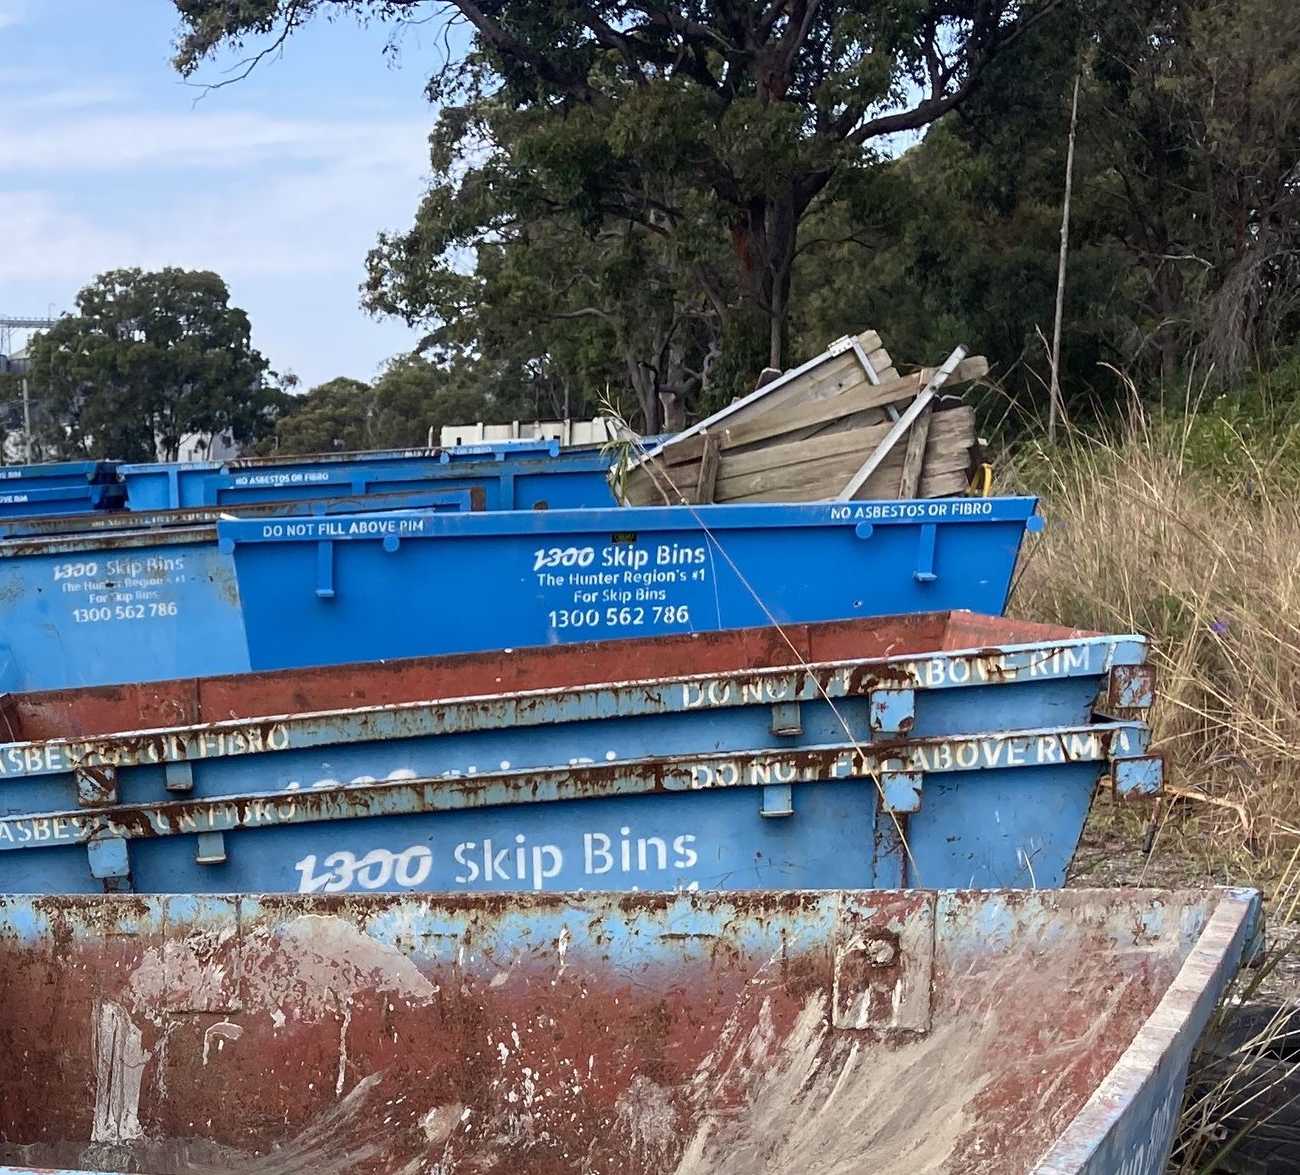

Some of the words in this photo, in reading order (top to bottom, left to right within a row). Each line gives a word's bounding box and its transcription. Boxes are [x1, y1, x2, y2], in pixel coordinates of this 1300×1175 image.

[831, 507, 850, 519] NO
[854, 505, 924, 518] ASBESTOS
[928, 504, 946, 515] OR
[952, 503, 992, 515] FIBRO
[263, 525, 282, 537] DO
[286, 524, 314, 536] NOT
[318, 522, 345, 535] FILL
[349, 520, 395, 533] ABOVE
[533, 547, 595, 571] 1300
[601, 545, 648, 570] Skip
[657, 544, 705, 565] Bins
[53, 562, 98, 580] 1300
[106, 559, 141, 577] Skip
[147, 557, 184, 572] Bins
[536, 574, 564, 586] The
[569, 573, 619, 585] Hunter
[624, 570, 687, 585] Region's
[692, 569, 705, 581] #1
[89, 594, 107, 604] For
[574, 590, 598, 603] For
[602, 588, 632, 603] Skip
[636, 587, 666, 601] Bins
[73, 607, 111, 622] 1300
[115, 605, 145, 619] 562
[148, 602, 178, 616] 786
[549, 609, 599, 627] 1300
[607, 608, 644, 625] 562
[652, 606, 689, 624] 786
[683, 680, 730, 707] DO
[907, 653, 1017, 686] ABOVE
[1031, 646, 1090, 677] RIM
[691, 762, 739, 789] DO
[912, 738, 1026, 770] ABOVE
[1037, 732, 1097, 763] RIM
[294, 845, 433, 894] 1300
[454, 833, 563, 890] Skip
[583, 826, 697, 874] Bins
